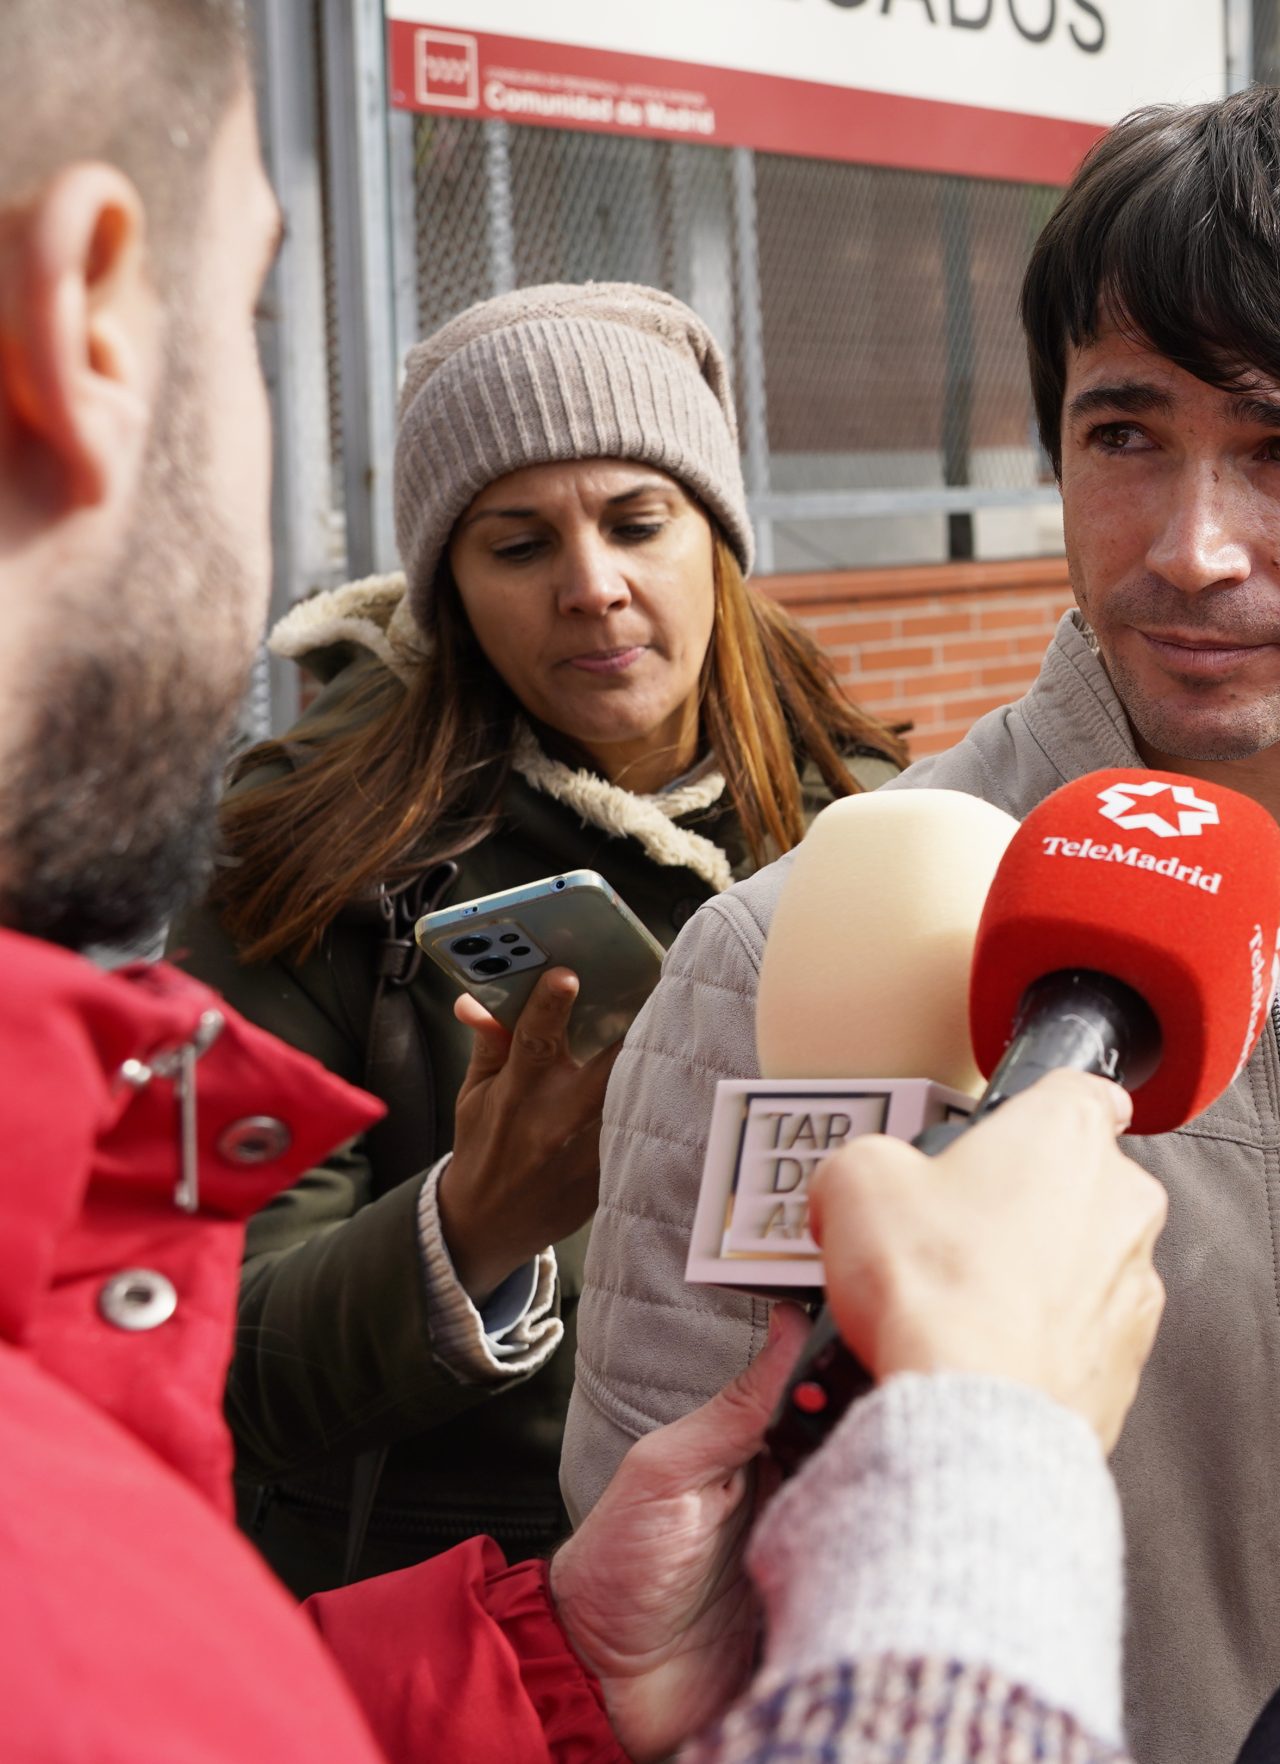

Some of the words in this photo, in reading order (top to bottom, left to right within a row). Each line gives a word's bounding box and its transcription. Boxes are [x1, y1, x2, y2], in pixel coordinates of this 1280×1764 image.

[483, 80, 614, 123] Comunidad
[644, 102, 715, 135] Madrid
[1042, 836, 1223, 894] TeleMadrid
